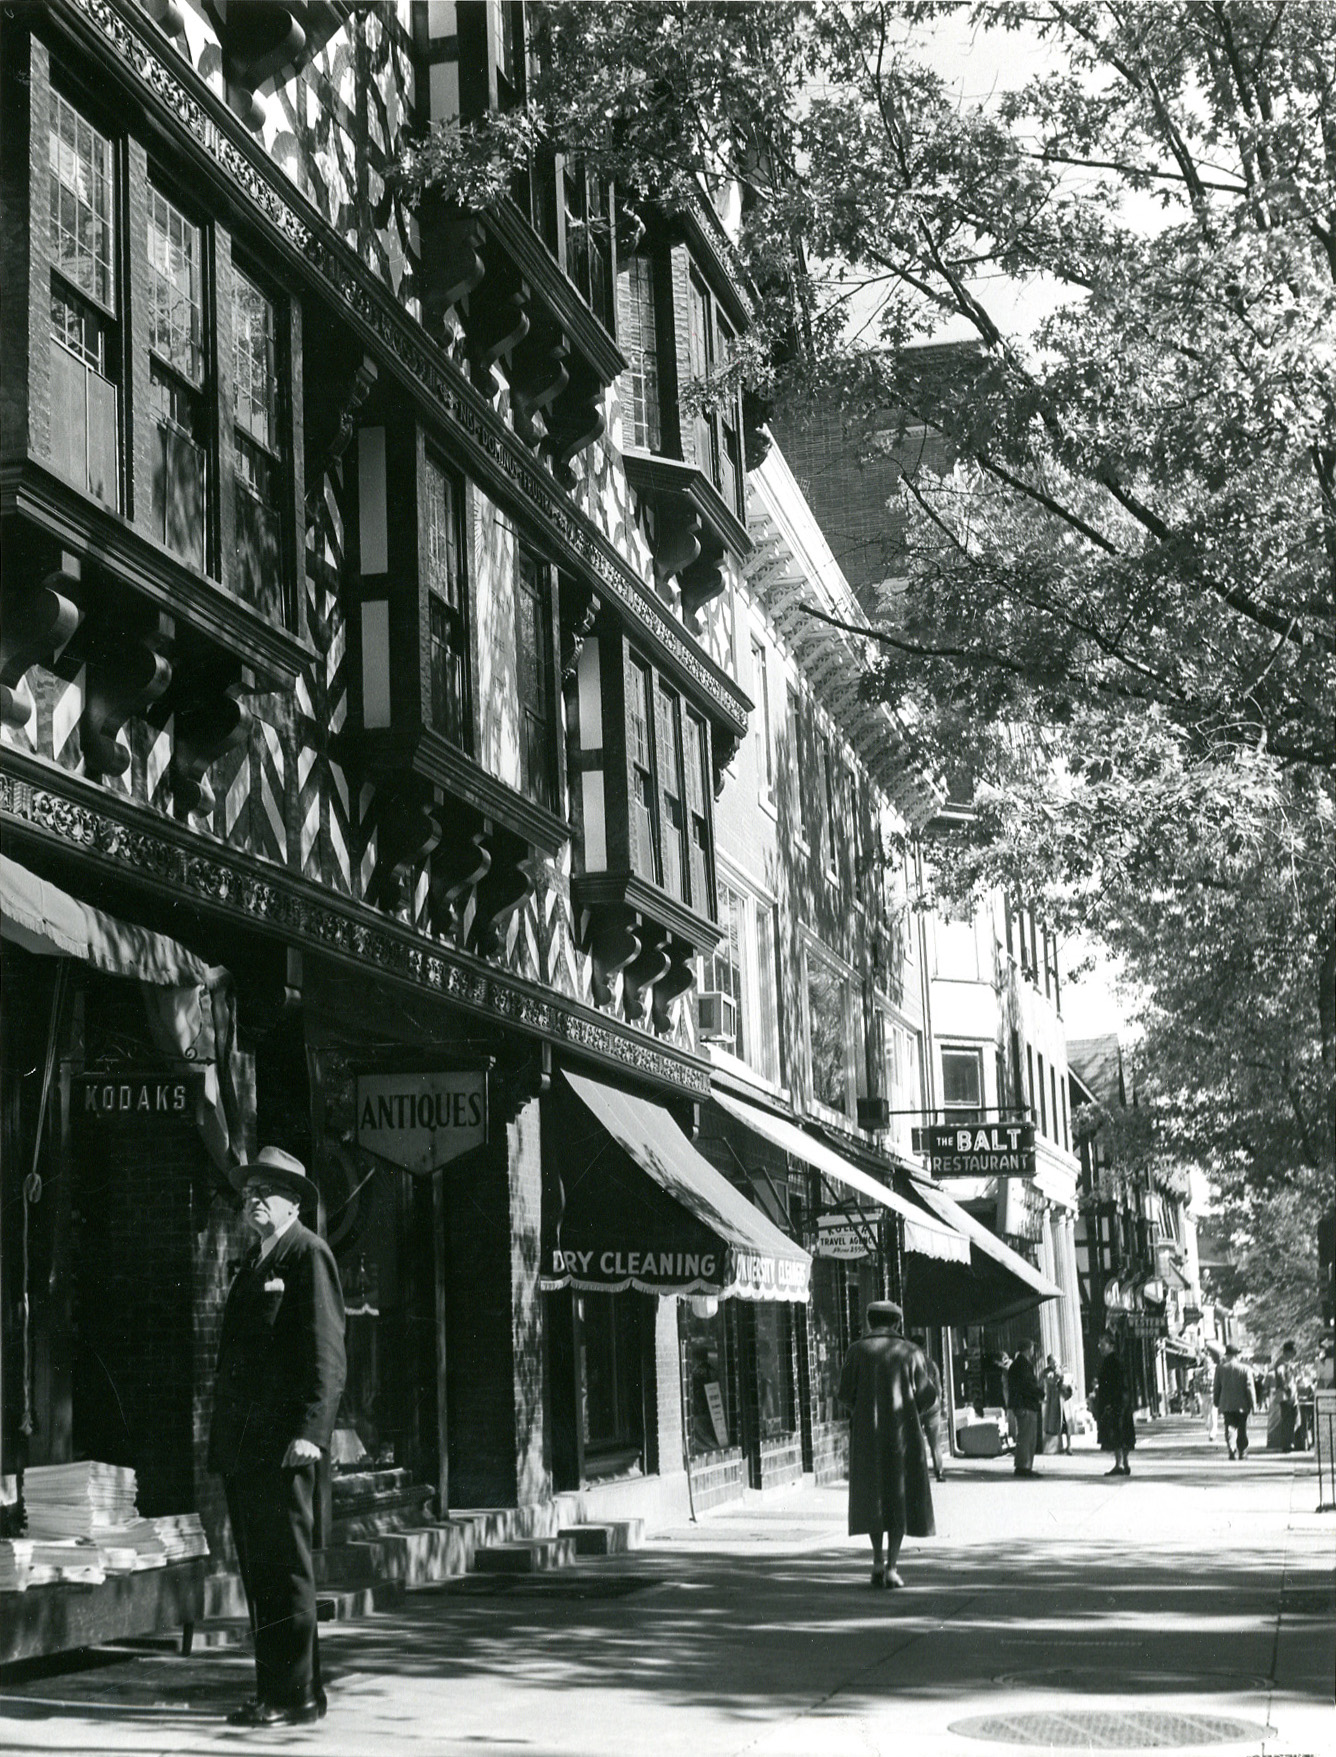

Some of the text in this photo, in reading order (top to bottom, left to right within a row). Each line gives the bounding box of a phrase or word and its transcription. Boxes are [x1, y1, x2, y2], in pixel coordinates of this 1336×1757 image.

[85, 1085, 185, 1110] KODAKS
[360, 1092, 481, 1132] ANTIQUES
[936, 1129, 1021, 1152] THE BALT
[933, 1154, 1028, 1171] RESTAURANT
[820, 1237, 846, 1246] TRAVEL
[552, 1250, 716, 1277] DRY CLEANING
